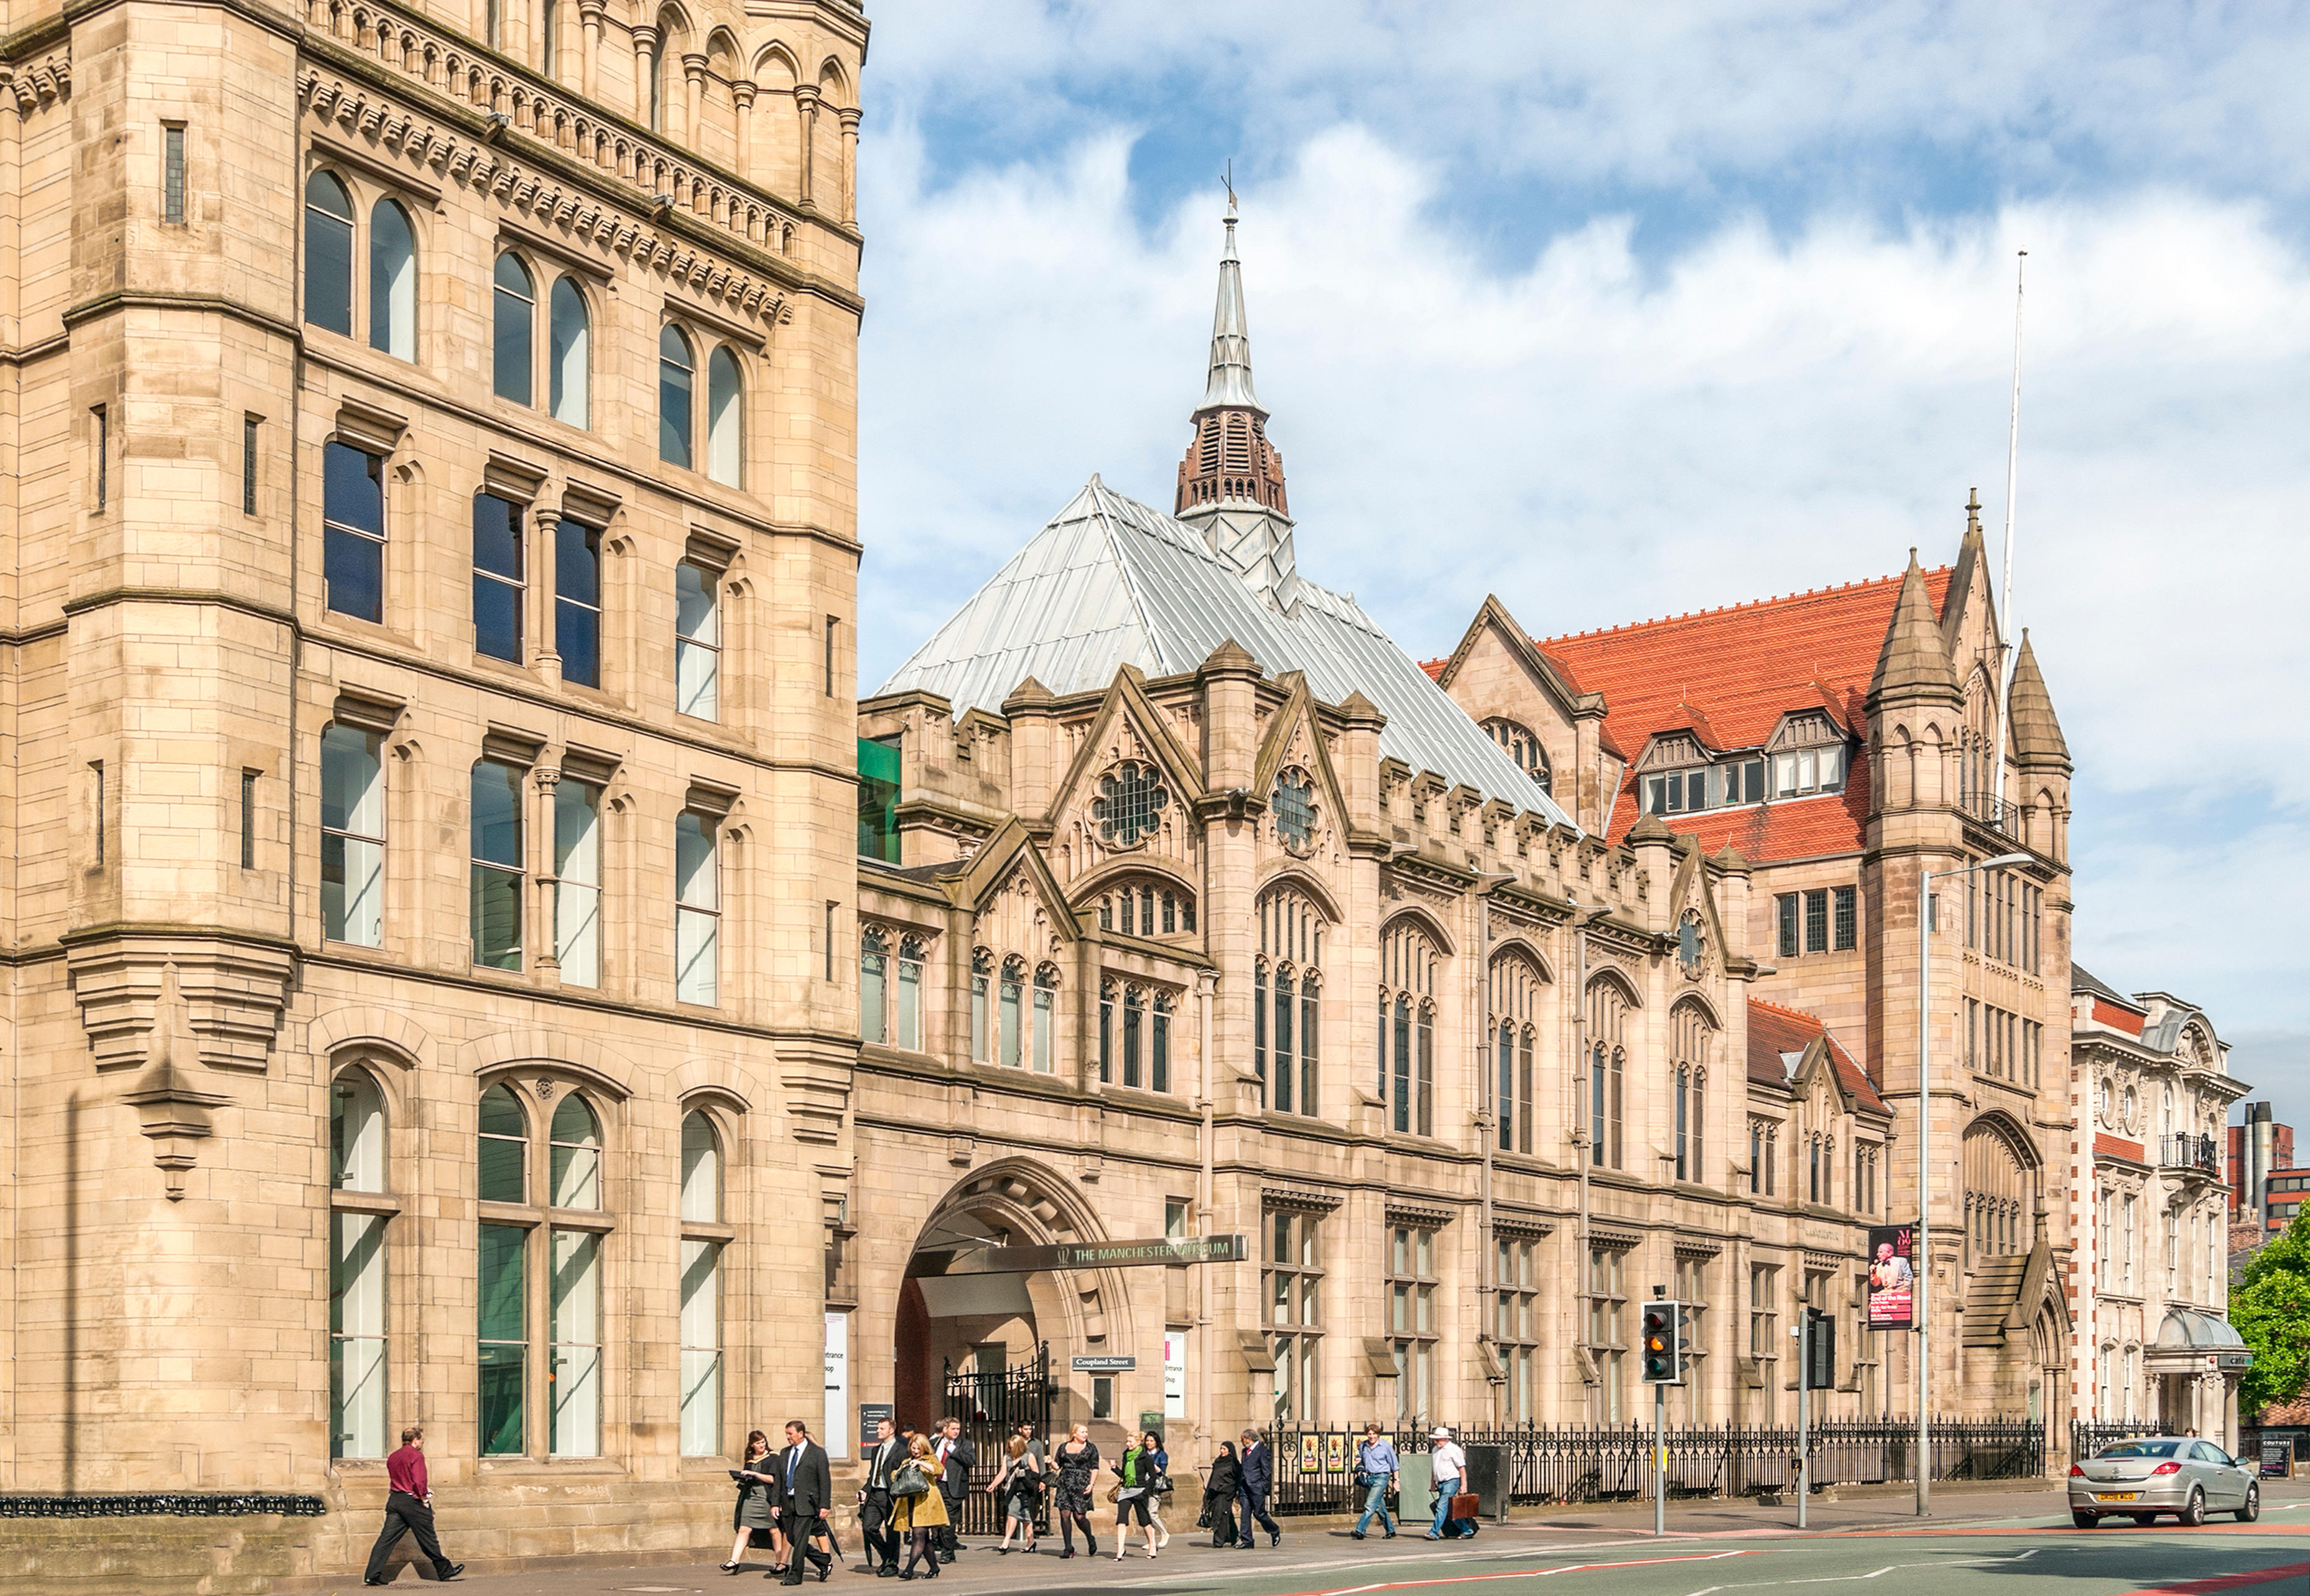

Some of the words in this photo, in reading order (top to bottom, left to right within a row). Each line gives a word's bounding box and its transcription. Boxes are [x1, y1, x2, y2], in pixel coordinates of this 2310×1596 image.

[1075, 1249, 1095, 1261] THE
[1098, 1245, 1172, 1260] MANCHESTER
[1176, 1243, 1228, 1255] MUSEUM
[1076, 1358, 1108, 1366] Coupland
